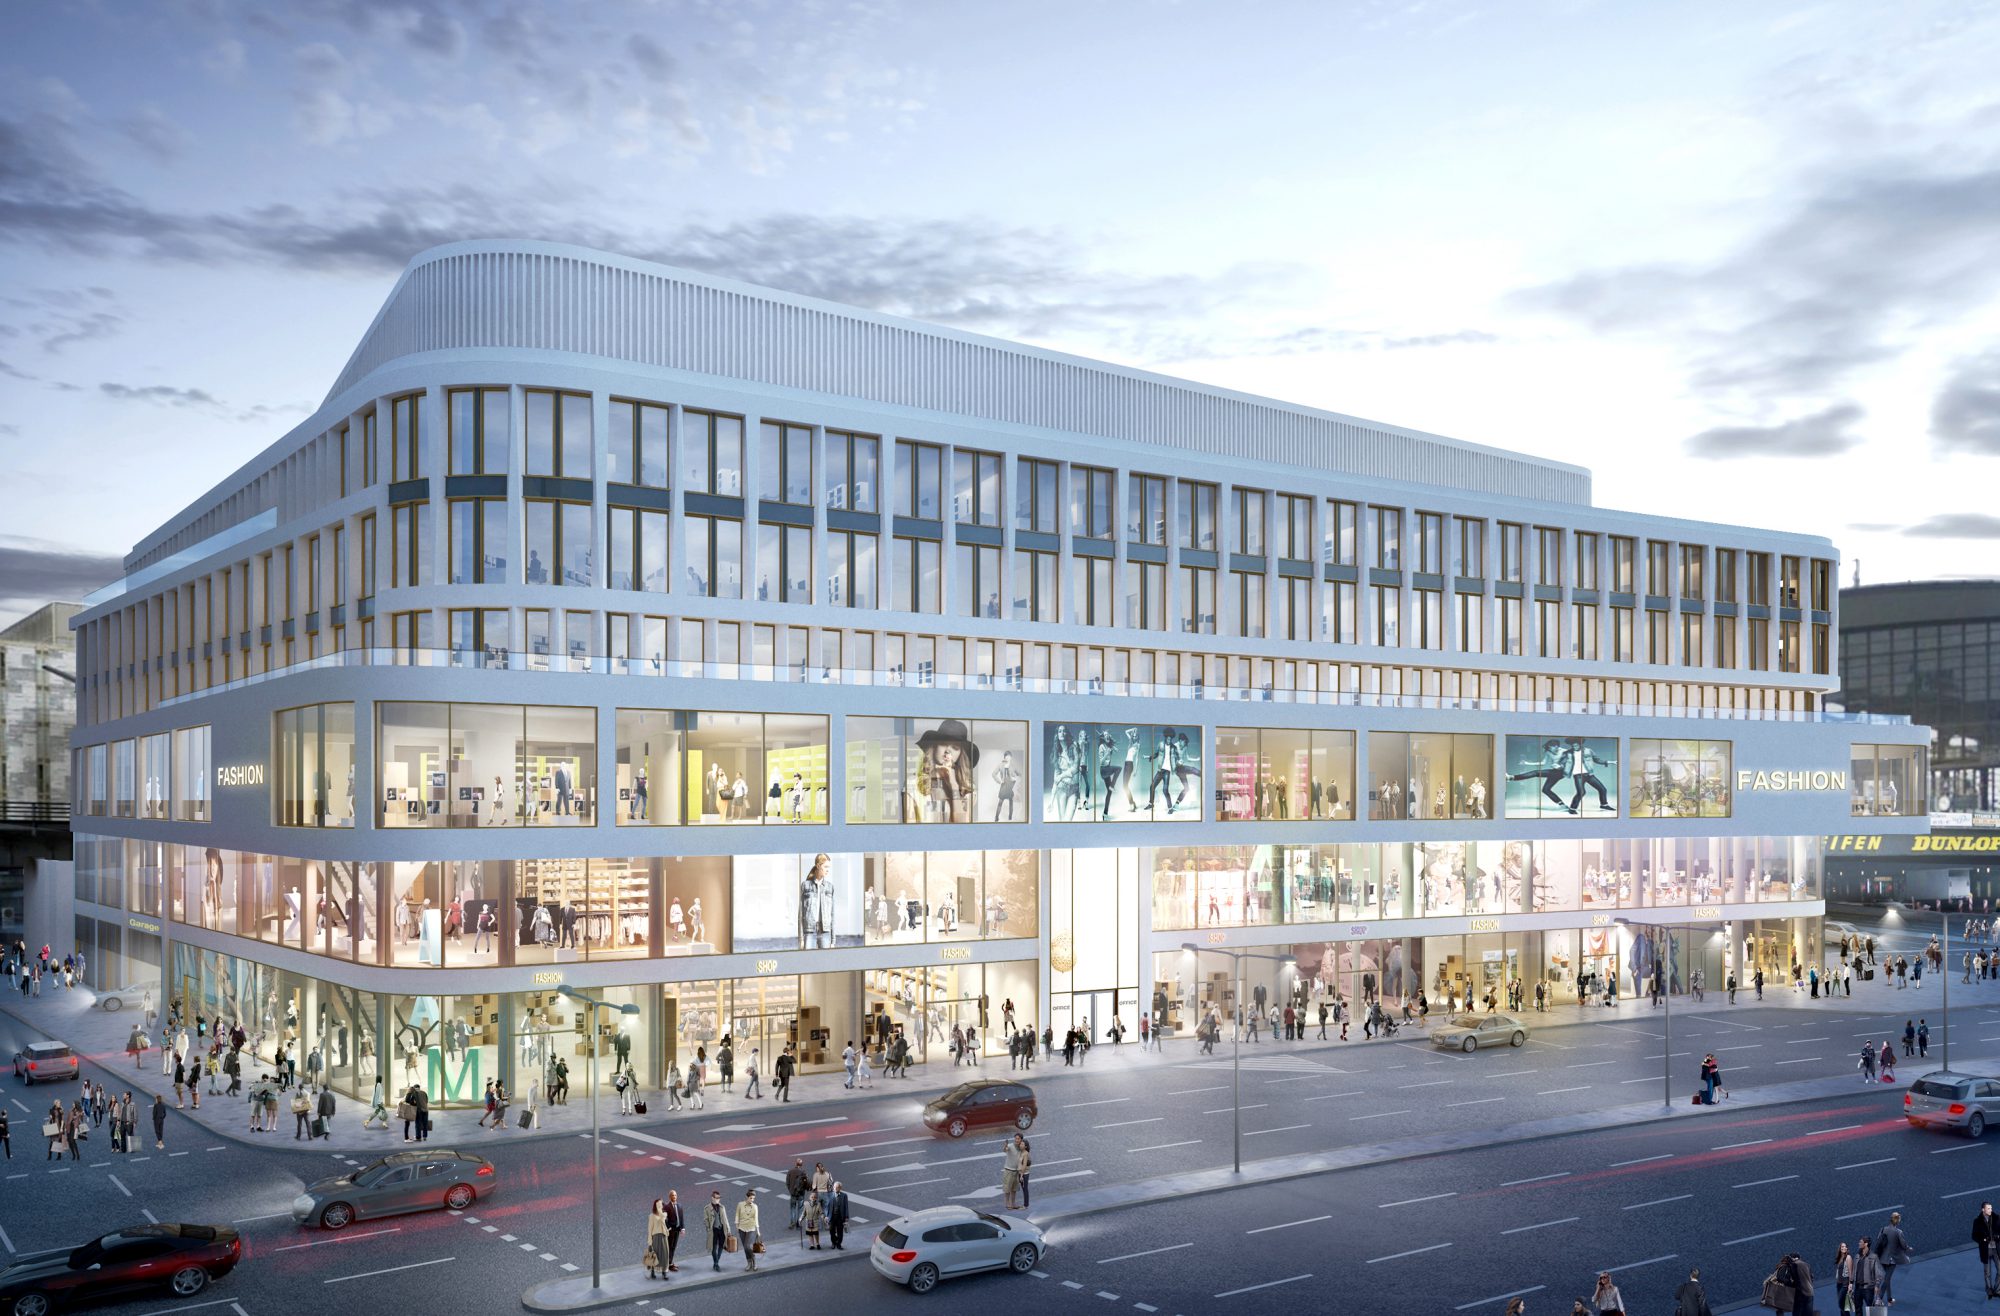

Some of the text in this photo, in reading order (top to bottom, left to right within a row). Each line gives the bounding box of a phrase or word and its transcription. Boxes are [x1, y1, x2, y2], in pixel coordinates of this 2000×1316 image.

[217, 764, 263, 786] FASHION
[1737, 770, 1846, 791] FASHION
[129, 918, 160, 932] Garage
[1471, 919, 1500, 931] FASHION
[942, 947, 971, 960] FASHION
[757, 960, 777, 973] SHOP
[534, 971, 562, 984] FASHION
